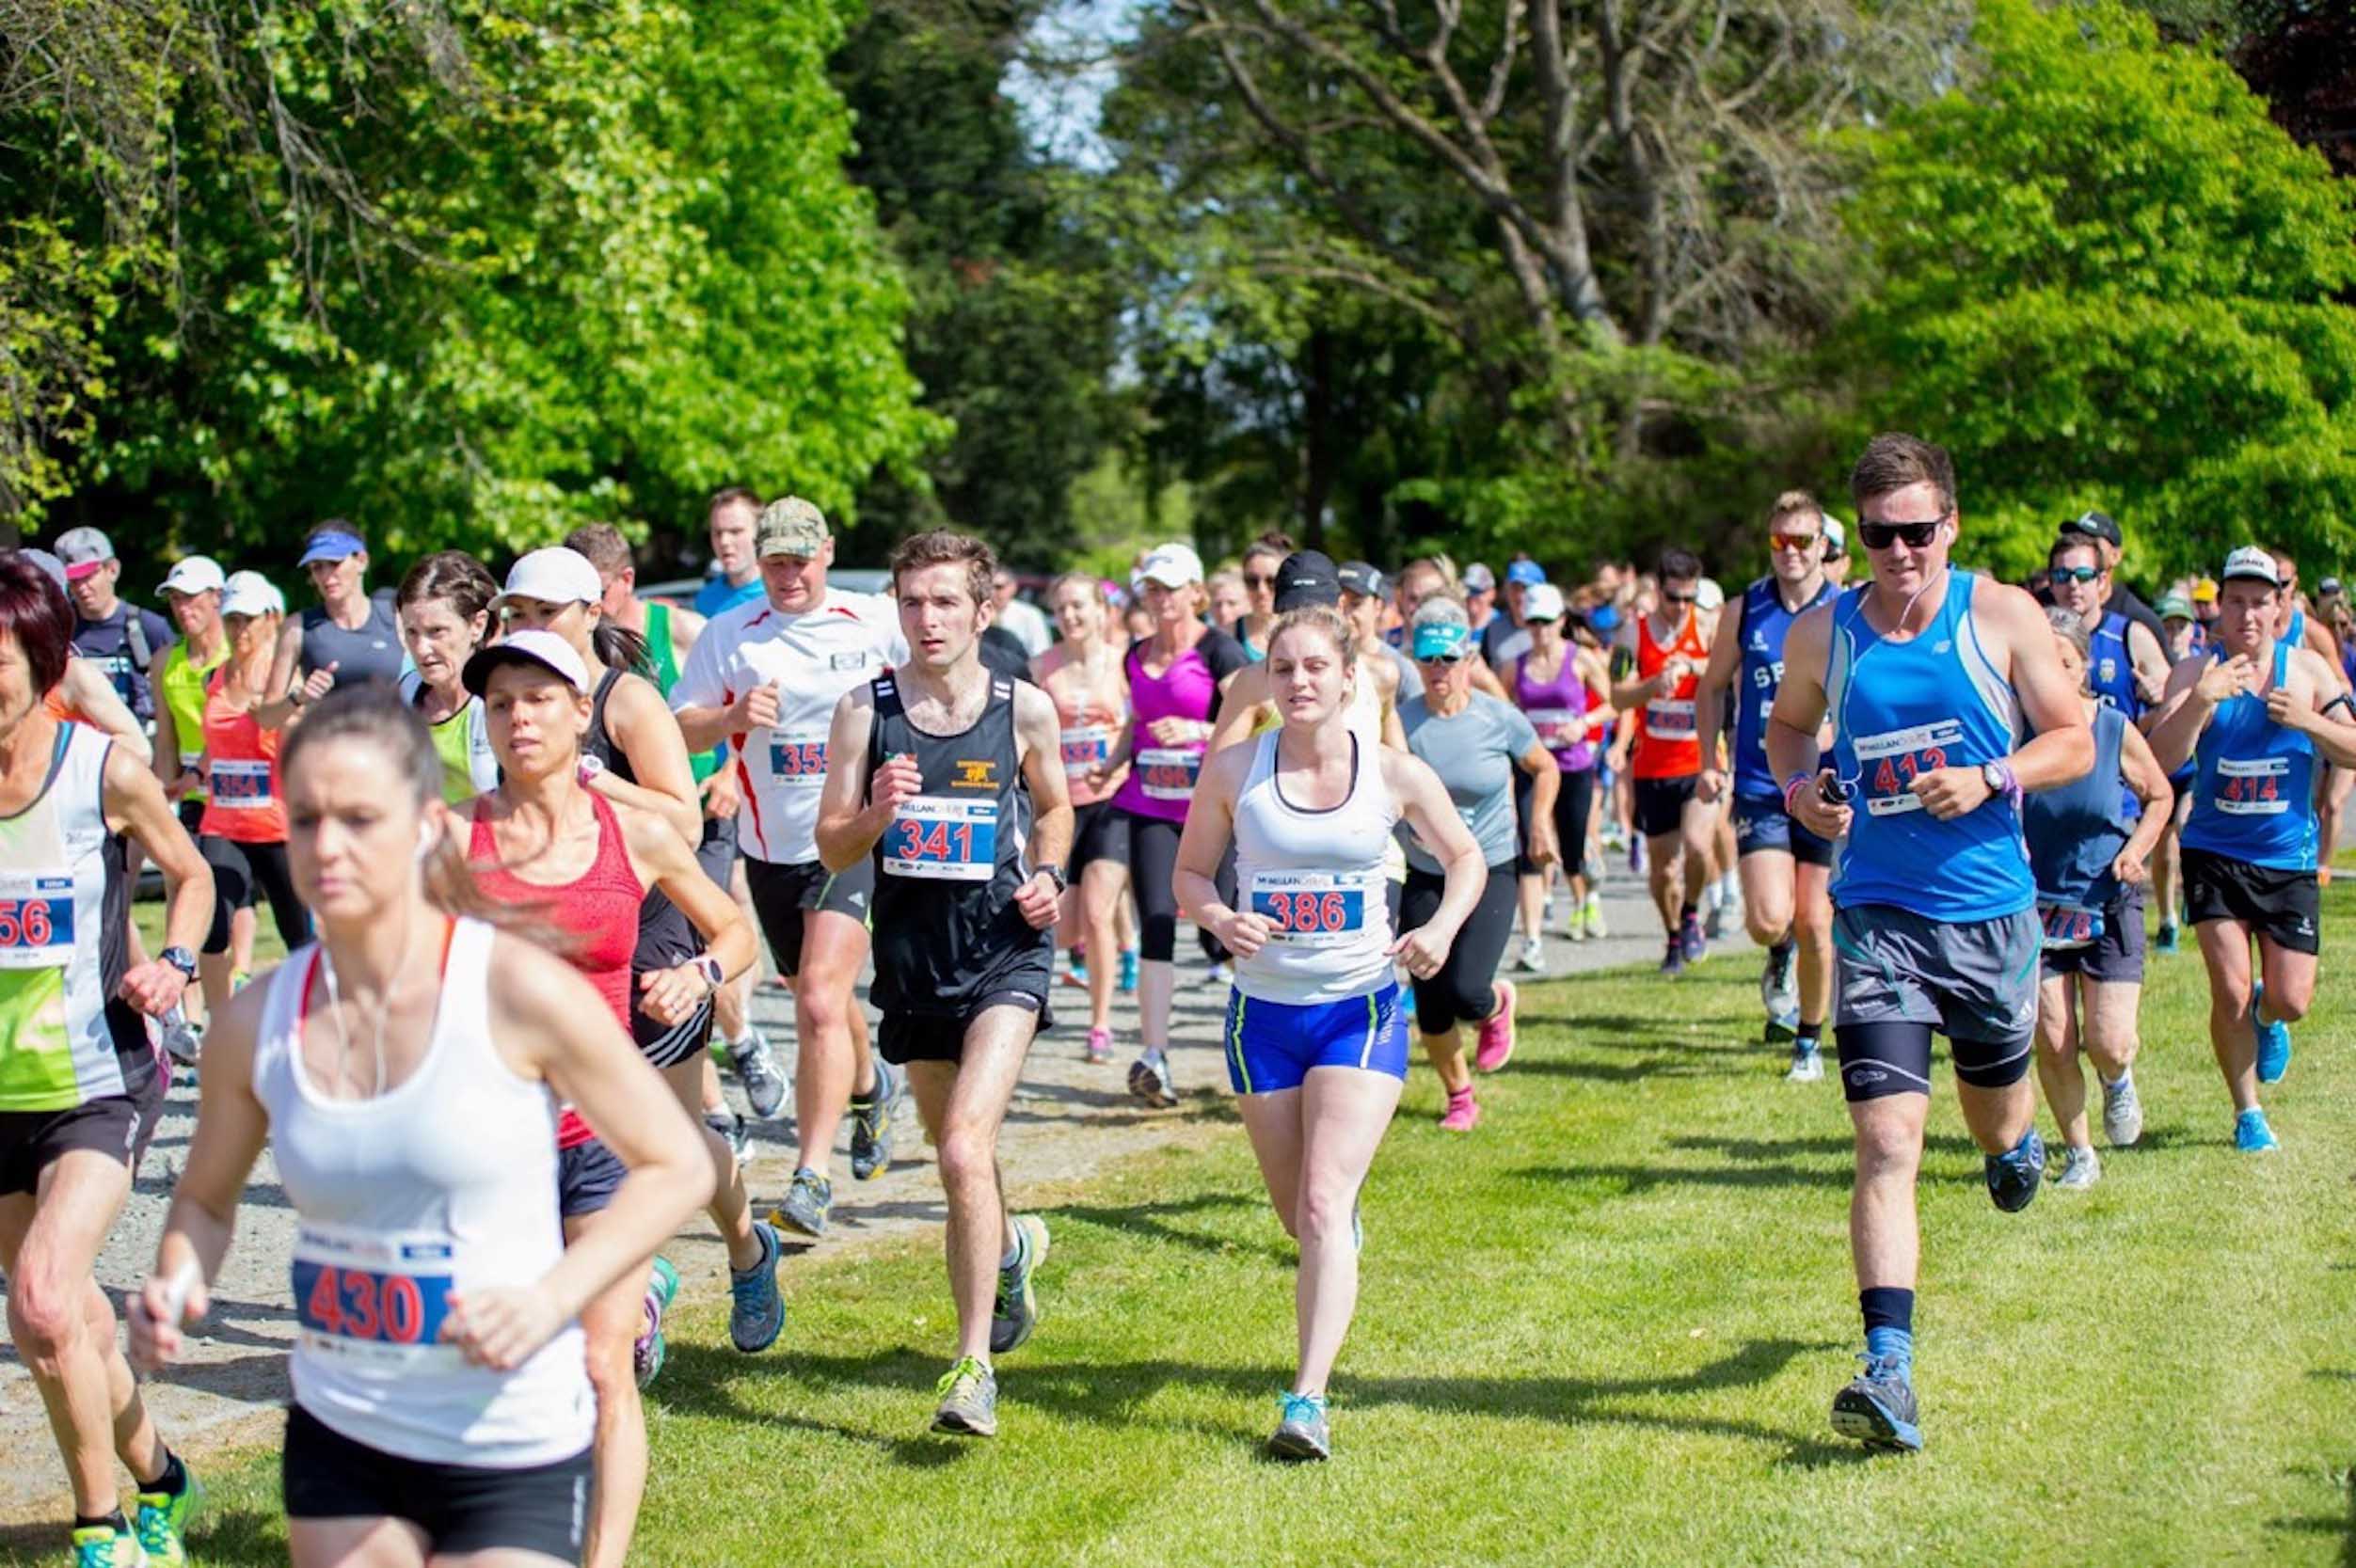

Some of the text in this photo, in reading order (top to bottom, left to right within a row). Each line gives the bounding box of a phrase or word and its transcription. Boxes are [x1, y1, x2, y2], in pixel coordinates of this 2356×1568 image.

[781, 743, 829, 776] 35
[2224, 775, 2279, 802] 414
[899, 819, 974, 863] 341
[1267, 892, 1346, 933] 386
[309, 1264, 424, 1344] 430
